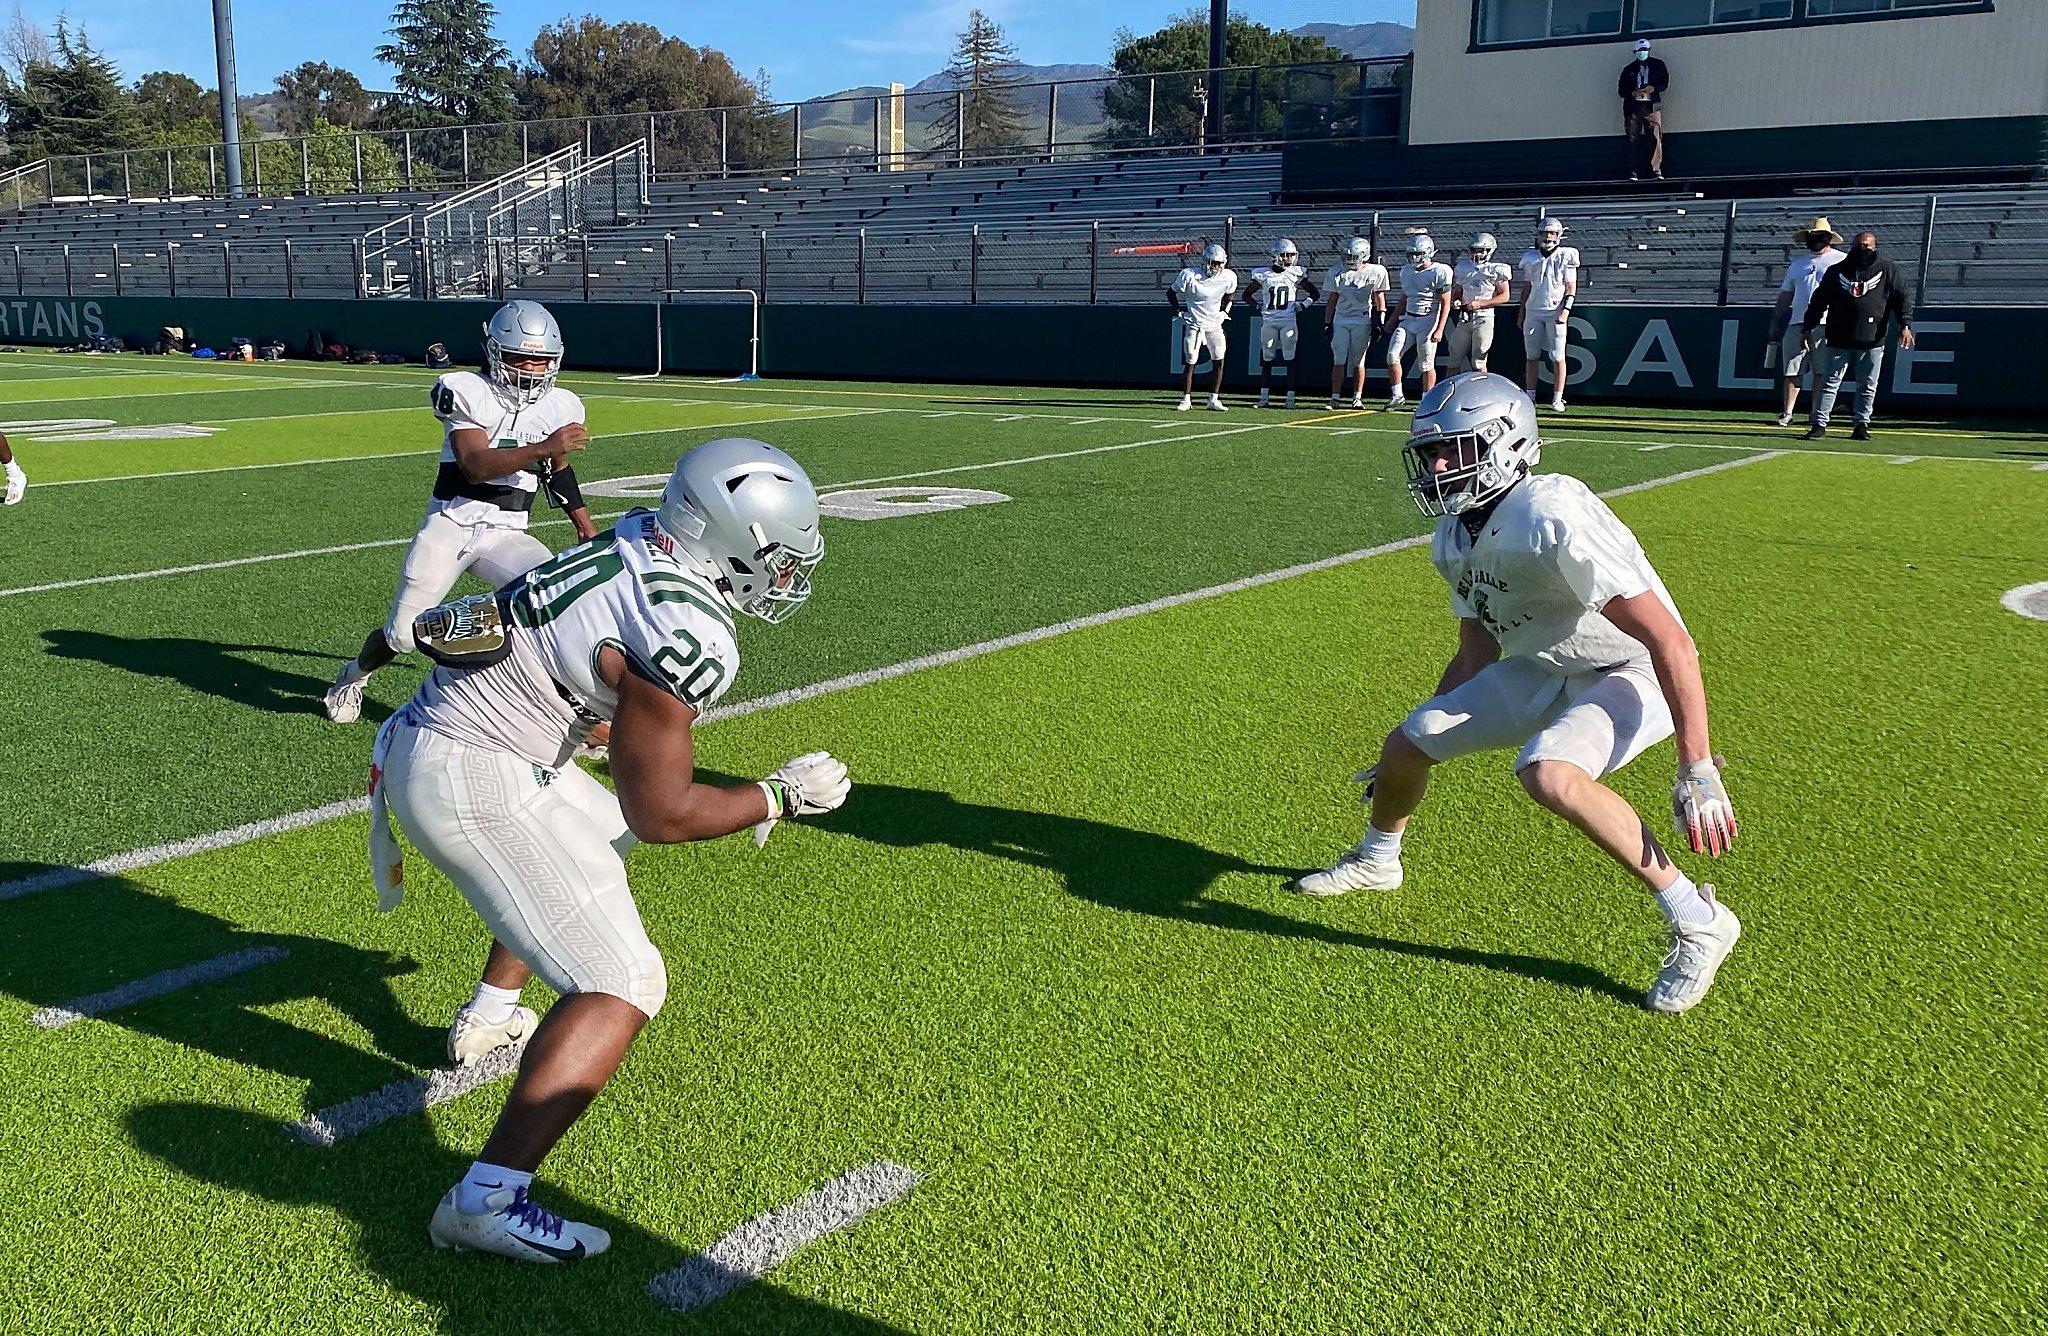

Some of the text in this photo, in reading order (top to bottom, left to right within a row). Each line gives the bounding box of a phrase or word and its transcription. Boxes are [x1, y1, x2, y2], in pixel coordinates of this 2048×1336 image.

[1267, 285, 1289, 310] 10
[1537, 316, 1965, 395] SALE
[650, 628, 726, 704] 20
